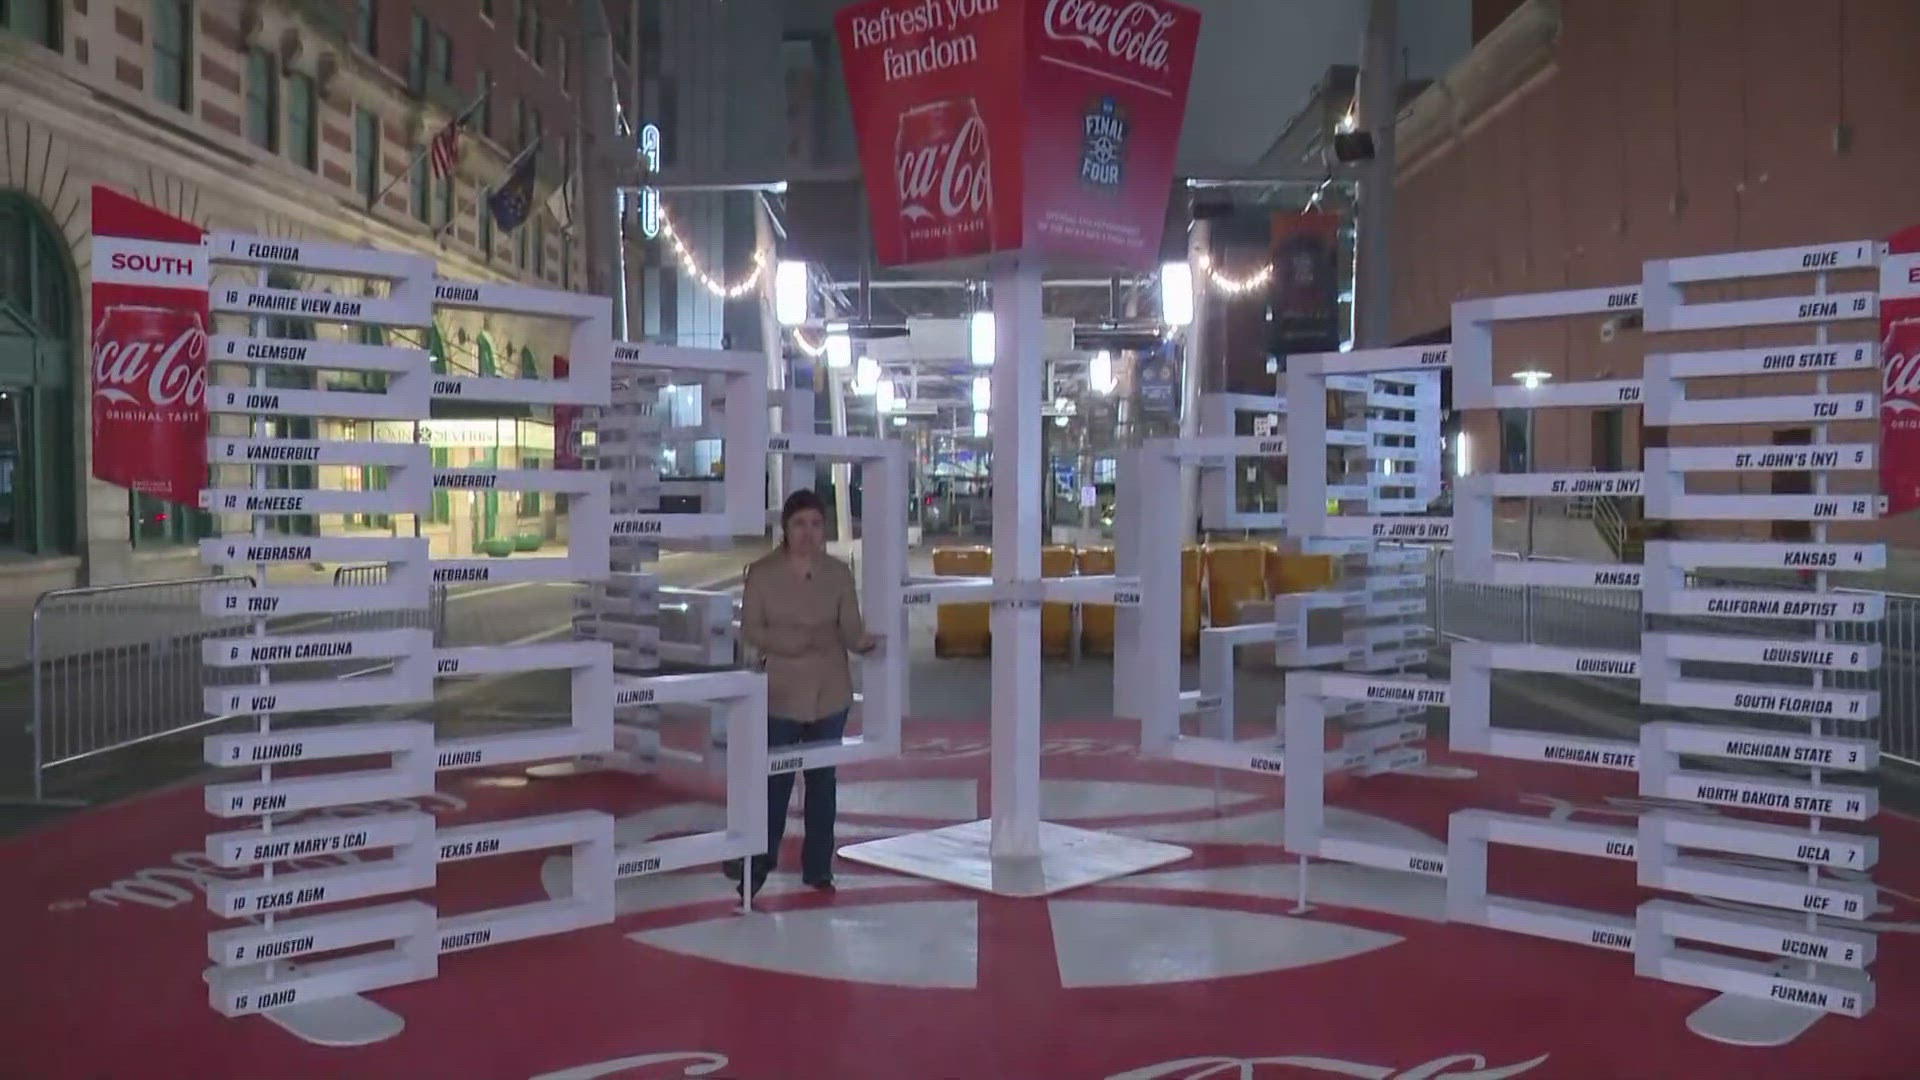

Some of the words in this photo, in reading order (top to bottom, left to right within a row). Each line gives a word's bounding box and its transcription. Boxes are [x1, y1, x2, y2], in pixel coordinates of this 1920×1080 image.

[852, 0, 942, 49] Refresh
[883, 34, 977, 82] fandom
[1086, 115, 1123, 142] FINAL
[1082, 158, 1119, 184] FOUR
[230, 240, 235, 252] 1
[249, 243, 300, 261] FLORIDA
[1803, 251, 1839, 267] DUKE
[1857, 247, 1862, 259] 1
[111, 253, 193, 276] SOUTH
[435, 285, 479, 301] FLORIDA
[1607, 293, 1638, 307] DUKE
[248, 294, 296, 311] PRAIRIE
[301, 297, 331, 314] VIEW
[333, 299, 361, 317] A&M
[1798, 303, 1838, 318] SIENA
[1852, 299, 1866, 311] 16
[247, 344, 306, 361] CLEMSON
[614, 347, 639, 361] IOWA
[1421, 351, 1447, 364] DUKE
[1763, 355, 1795, 369] OHIO
[1799, 352, 1838, 367] STATE
[1854, 349, 1862, 361] 8
[433, 381, 461, 395] IOWA
[1618, 387, 1640, 400] TCU
[227, 392, 234, 405] 9
[246, 395, 279, 409] IOWA
[1813, 403, 1838, 416] TCU
[1855, 400, 1863, 412] 9
[227, 444, 234, 457] 5
[246, 446, 320, 461] VANDERBILT
[768, 438, 790, 450] IOWA
[1260, 442, 1283, 453] DUKE
[1736, 454, 1754, 468] ST.
[1757, 453, 1807, 467] JOHN'S
[1811, 451, 1838, 467] (NY)
[1855, 451, 1863, 463] 5
[433, 474, 496, 489] VANDERBILT
[1552, 480, 1568, 492] ST.
[1571, 479, 1613, 493] JOHN'S
[1616, 478, 1640, 493] (NY)
[224, 495, 236, 508] 12
[246, 497, 302, 510] McNEESE
[1813, 503, 1837, 516] UNI
[1852, 501, 1865, 514] 12
[613, 521, 661, 534] NEBRASKA
[1372, 524, 1386, 536] ST.
[1389, 523, 1426, 536] JOHN'S
[1428, 524, 1449, 537] (NY)
[227, 546, 235, 558] 4
[247, 546, 312, 561] NEBRASKA
[1784, 552, 1836, 566] KANSAS
[1854, 551, 1862, 563] 4
[433, 568, 489, 582] NEBRASKA
[1595, 573, 1640, 585] KANSAS
[226, 596, 237, 609] 13
[246, 597, 279, 612] TROY
[902, 593, 931, 604] ILLINOIS
[1114, 592, 1141, 604] UCONN
[1708, 600, 1779, 614] CALIFORNIA
[1783, 601, 1838, 617] BAPTIST
[1852, 602, 1865, 614] 13
[231, 647, 238, 660] 6
[251, 645, 292, 661] NORTH
[295, 641, 352, 658] CAROLINA
[1763, 648, 1834, 665] LOUISVILLE
[1850, 652, 1858, 664] 6
[437, 659, 459, 673] VCU
[1576, 658, 1636, 675] LOUISVILLE
[231, 696, 239, 710] 11
[251, 696, 276, 710] VCU
[617, 689, 654, 705] ILLINOIS
[1367, 686, 1415, 701] MICHIGAN
[1417, 689, 1445, 703] STATE
[1734, 694, 1775, 710] SOUTH
[1779, 696, 1832, 714] FLORIDA
[1849, 701, 1858, 713] 11
[232, 747, 240, 760] 3
[252, 743, 303, 761] ILLINOIS
[438, 750, 482, 767] ILLINOIS
[1545, 746, 1599, 763] MICHIGAN
[1602, 753, 1635, 768] STATE
[1727, 741, 1790, 760] MICHIGAN
[1794, 747, 1833, 764] STATE
[1849, 751, 1856, 763] 3
[770, 757, 803, 772] ILLINOIS
[1251, 757, 1281, 772] UCONN
[231, 797, 243, 810] 14
[253, 795, 286, 811] PENN
[1698, 786, 1738, 803] NORTH
[1742, 791, 1790, 809] DAKOTA
[1794, 796, 1833, 813] STATE
[1845, 800, 1859, 813] 14
[235, 847, 242, 860] 7
[254, 842, 290, 860] SAINT
[293, 835, 340, 855] MARY'S
[343, 832, 367, 849] (CA)
[440, 842, 473, 859] TEXAS
[475, 839, 500, 854] A&M
[1606, 842, 1634, 857] UCLA
[1797, 845, 1830, 862] UCLA
[1848, 851, 1856, 862] 7
[618, 857, 660, 876] HOUSTON
[1409, 857, 1443, 873] UCONN
[234, 897, 245, 910] 10
[256, 891, 293, 910] TEXAS
[297, 887, 324, 903] A&M
[1803, 895, 1830, 911] UCF
[1844, 900, 1857, 912] 10
[236, 947, 244, 959] 2
[257, 936, 314, 960] HOUSTON
[441, 930, 491, 950] HOUSTON
[1592, 931, 1631, 948] UCONN
[1782, 938, 1828, 959] UCONN
[1845, 949, 1853, 960] 2
[236, 996, 247, 1010] 15
[258, 989, 296, 1009] IDAHO
[1771, 985, 1827, 1007] FURMAN
[1842, 997, 1854, 1009] 15
